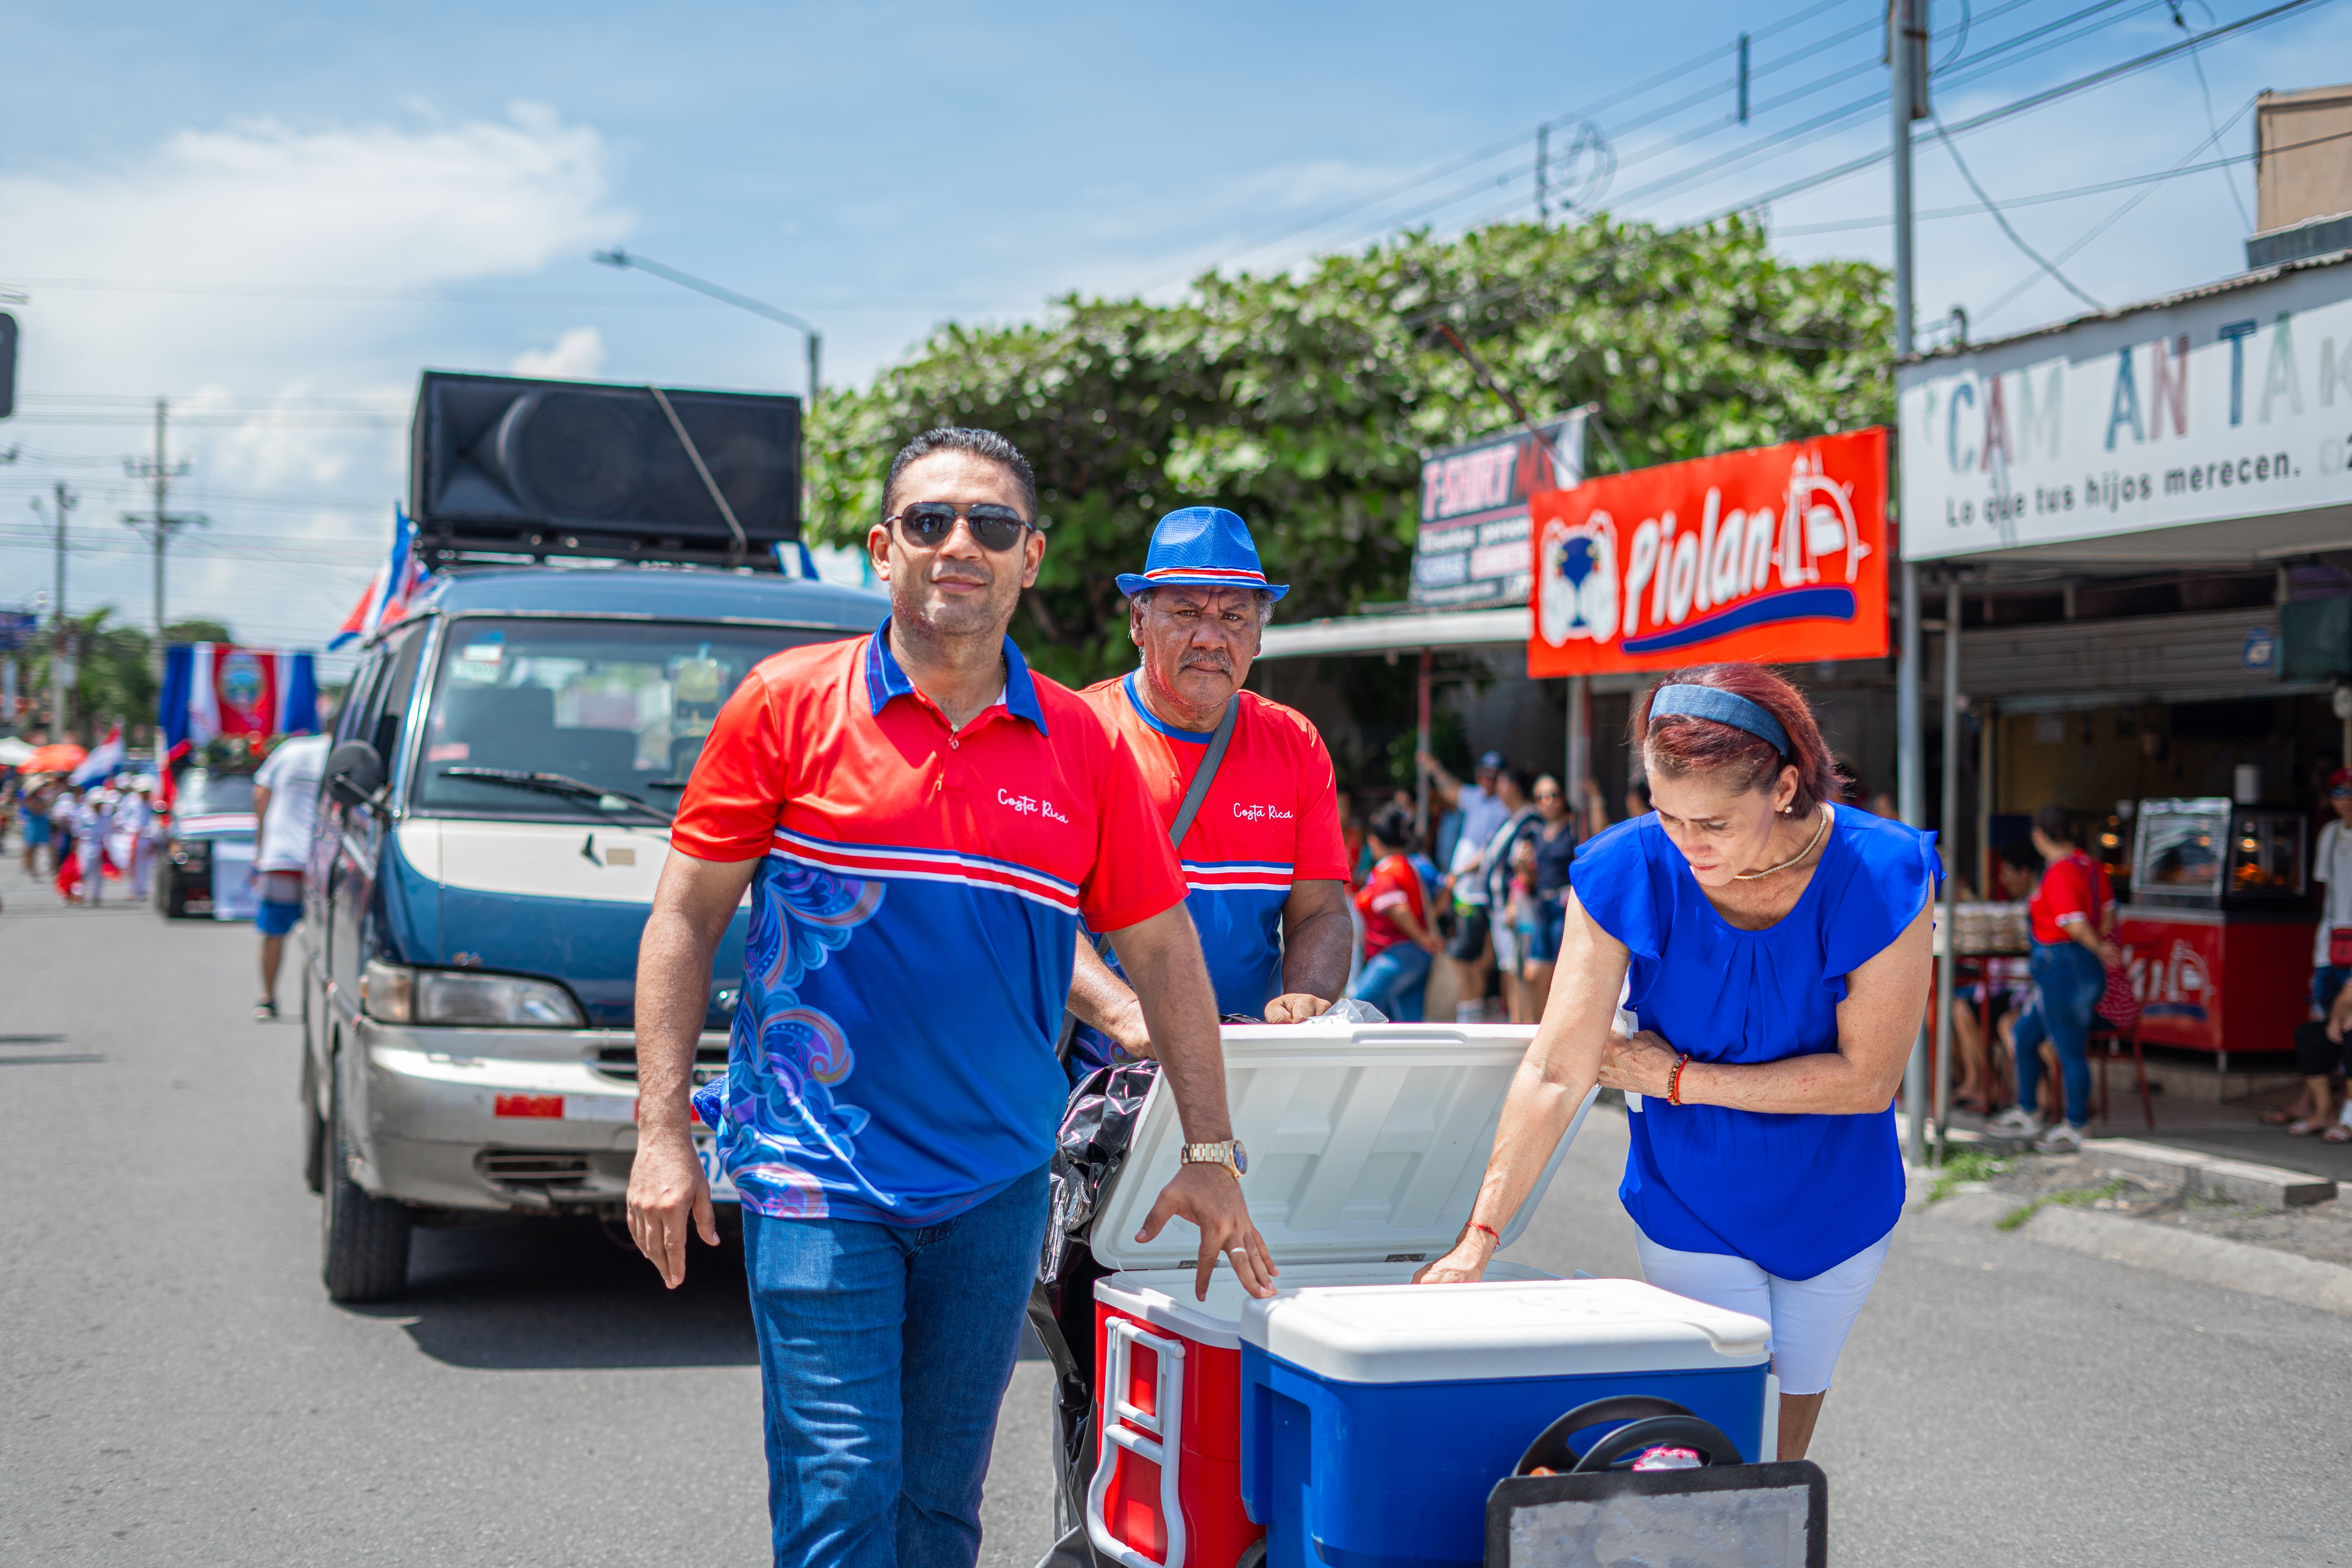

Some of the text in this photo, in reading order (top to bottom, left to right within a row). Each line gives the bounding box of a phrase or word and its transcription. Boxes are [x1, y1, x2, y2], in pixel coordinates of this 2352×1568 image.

[1946, 452, 2301, 530] Lo que tus hijos merecen.
[997, 788, 1069, 823] Costa Rica
[1233, 802, 1293, 822] Costa Rica
